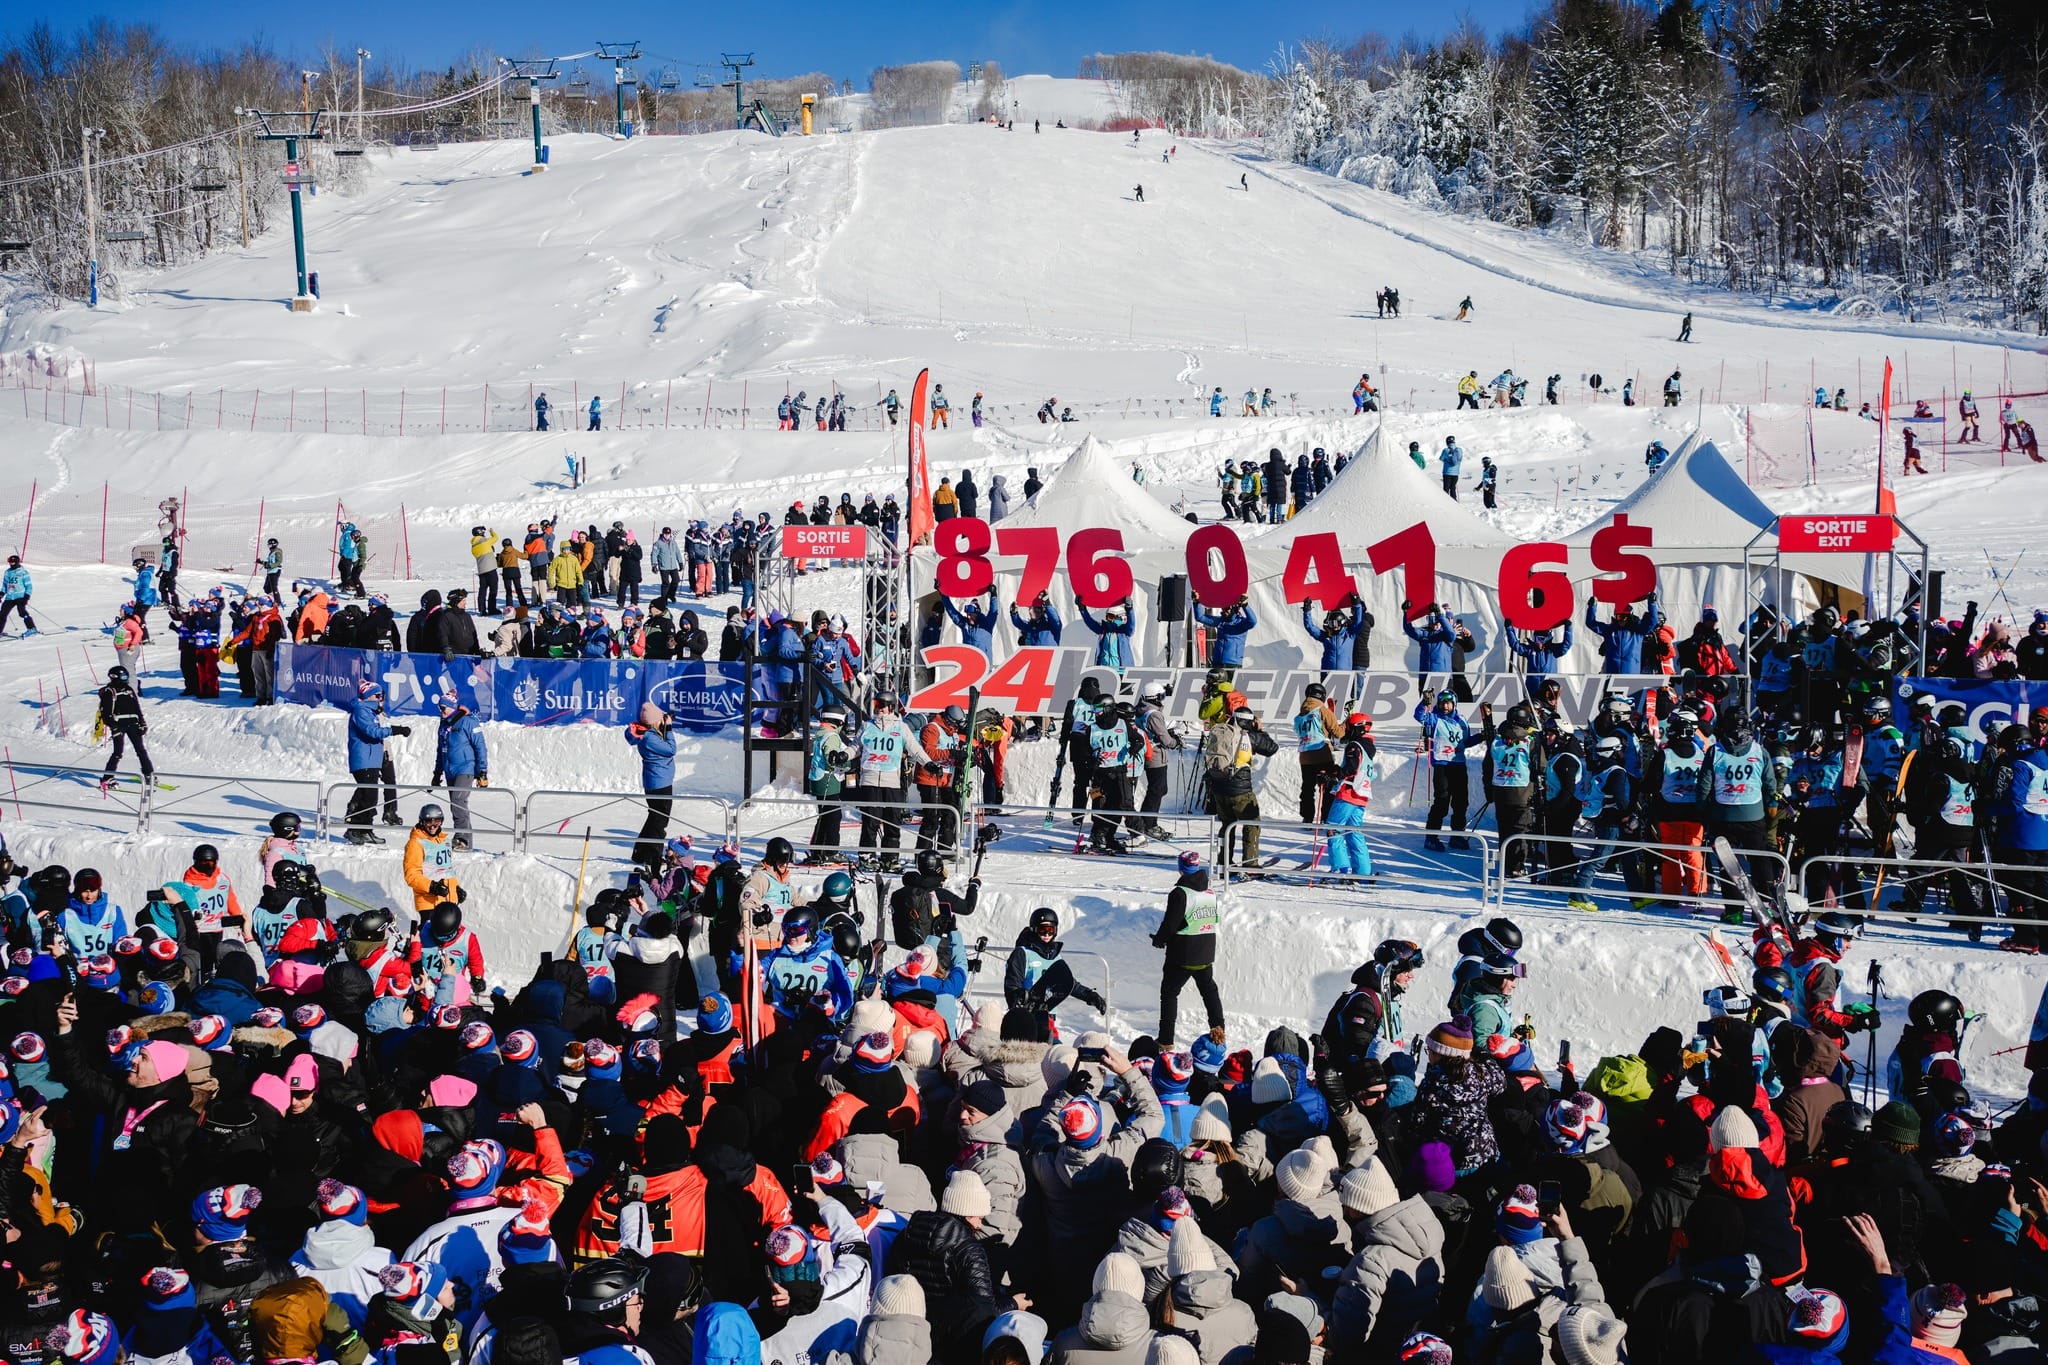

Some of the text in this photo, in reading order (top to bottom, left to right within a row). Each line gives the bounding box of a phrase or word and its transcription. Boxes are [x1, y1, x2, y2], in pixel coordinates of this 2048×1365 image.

[1803, 520, 1867, 534] SORTIE
[797, 531, 850, 544] SORTIE
[1818, 535, 1852, 547] EXIT
[811, 545, 835, 555] EXIT
[296, 673, 351, 688] AIR CANADA
[544, 689, 626, 711] Sun Life
[659, 689, 746, 716] TREMBLAN
[872, 736, 895, 752] 110
[1100, 735, 1120, 749] 161
[1448, 730, 1461, 744] 86
[1501, 753, 1516, 768] 42
[1725, 764, 1754, 781] 669
[84, 933, 106, 953] 56
[585, 965, 609, 978] 24
[1925, 1013, 1935, 1027] poc
[598, 1286, 640, 1312] GIRO
